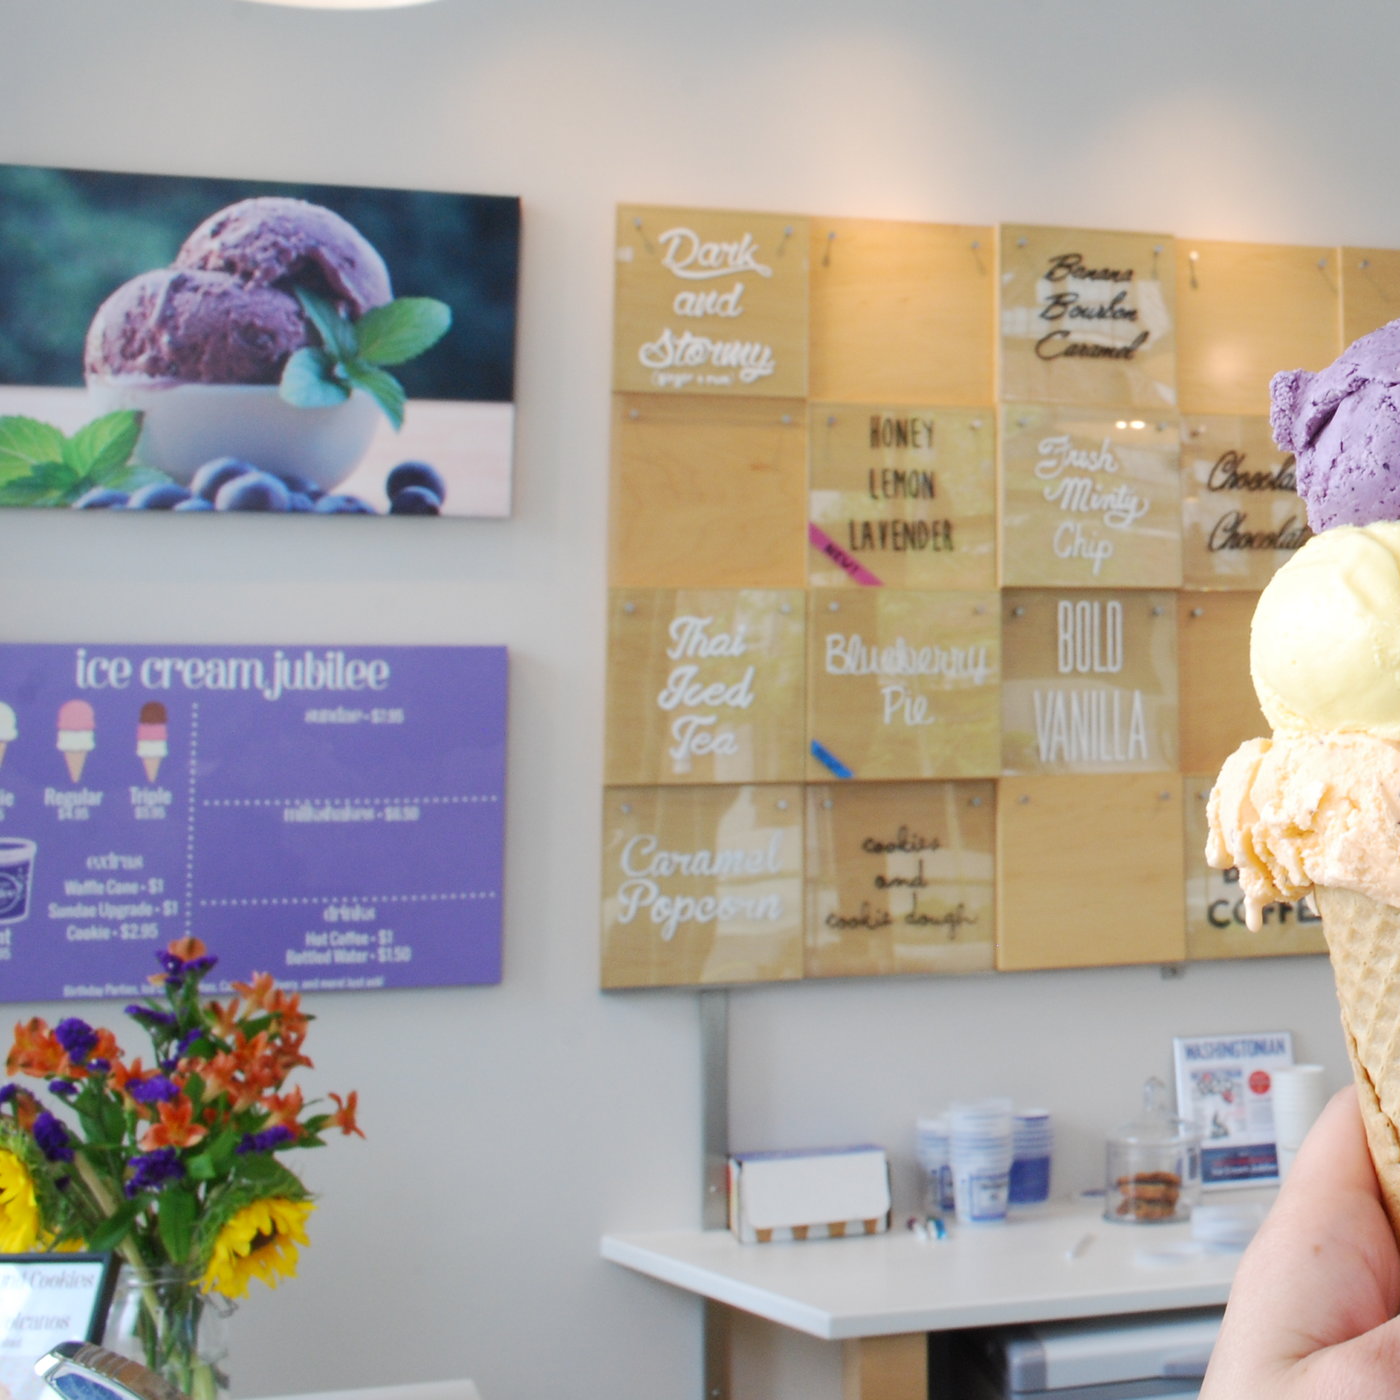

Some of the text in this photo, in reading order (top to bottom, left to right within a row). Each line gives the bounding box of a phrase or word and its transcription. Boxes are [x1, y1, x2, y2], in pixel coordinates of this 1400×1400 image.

[658, 227, 772, 280] Dark
[1045, 253, 1133, 282] Banana
[673, 282, 745, 317] and
[1039, 291, 1138, 321] Bourbon
[638, 328, 776, 383] Stormy
[1035, 330, 1149, 361] Caramel
[869, 415, 935, 449] HONEY
[1034, 434, 1119, 479] Fresh
[869, 468, 935, 500] LEMON
[1043, 475, 1151, 530] Minty
[848, 519, 954, 552] LAVENDER
[1053, 519, 1113, 576] Chip
[667, 615, 747, 660] Thai
[1058, 600, 1123, 672] BOLD
[75, 647, 391, 701] ice cream jubilee
[825, 633, 993, 684] Blueberry
[657, 665, 756, 709] Iced
[881, 685, 936, 725] Pie
[669, 714, 739, 760] Tea
[1033, 689, 1149, 762] VANILLA
[44, 787, 103, 807] Regular
[130, 786, 172, 805] Triple
[620, 828, 783, 878] Caramel
[861, 826, 941, 854] cookies
[64, 878, 164, 895] Waffle Cone $1
[874, 860, 928, 889] and
[48, 900, 178, 919] Sundae Upgrade $1
[617, 878, 784, 941] Popcorn
[825, 893, 977, 940] cookie dough
[66, 923, 158, 941] Cookie $2.95
[305, 931, 328, 946] Hot
[329, 931, 369, 946] Coffee
[286, 949, 332, 965] Bottled
[333, 948, 368, 963] Water
[1185, 1038, 1286, 1061] WASHINGTONIAN
